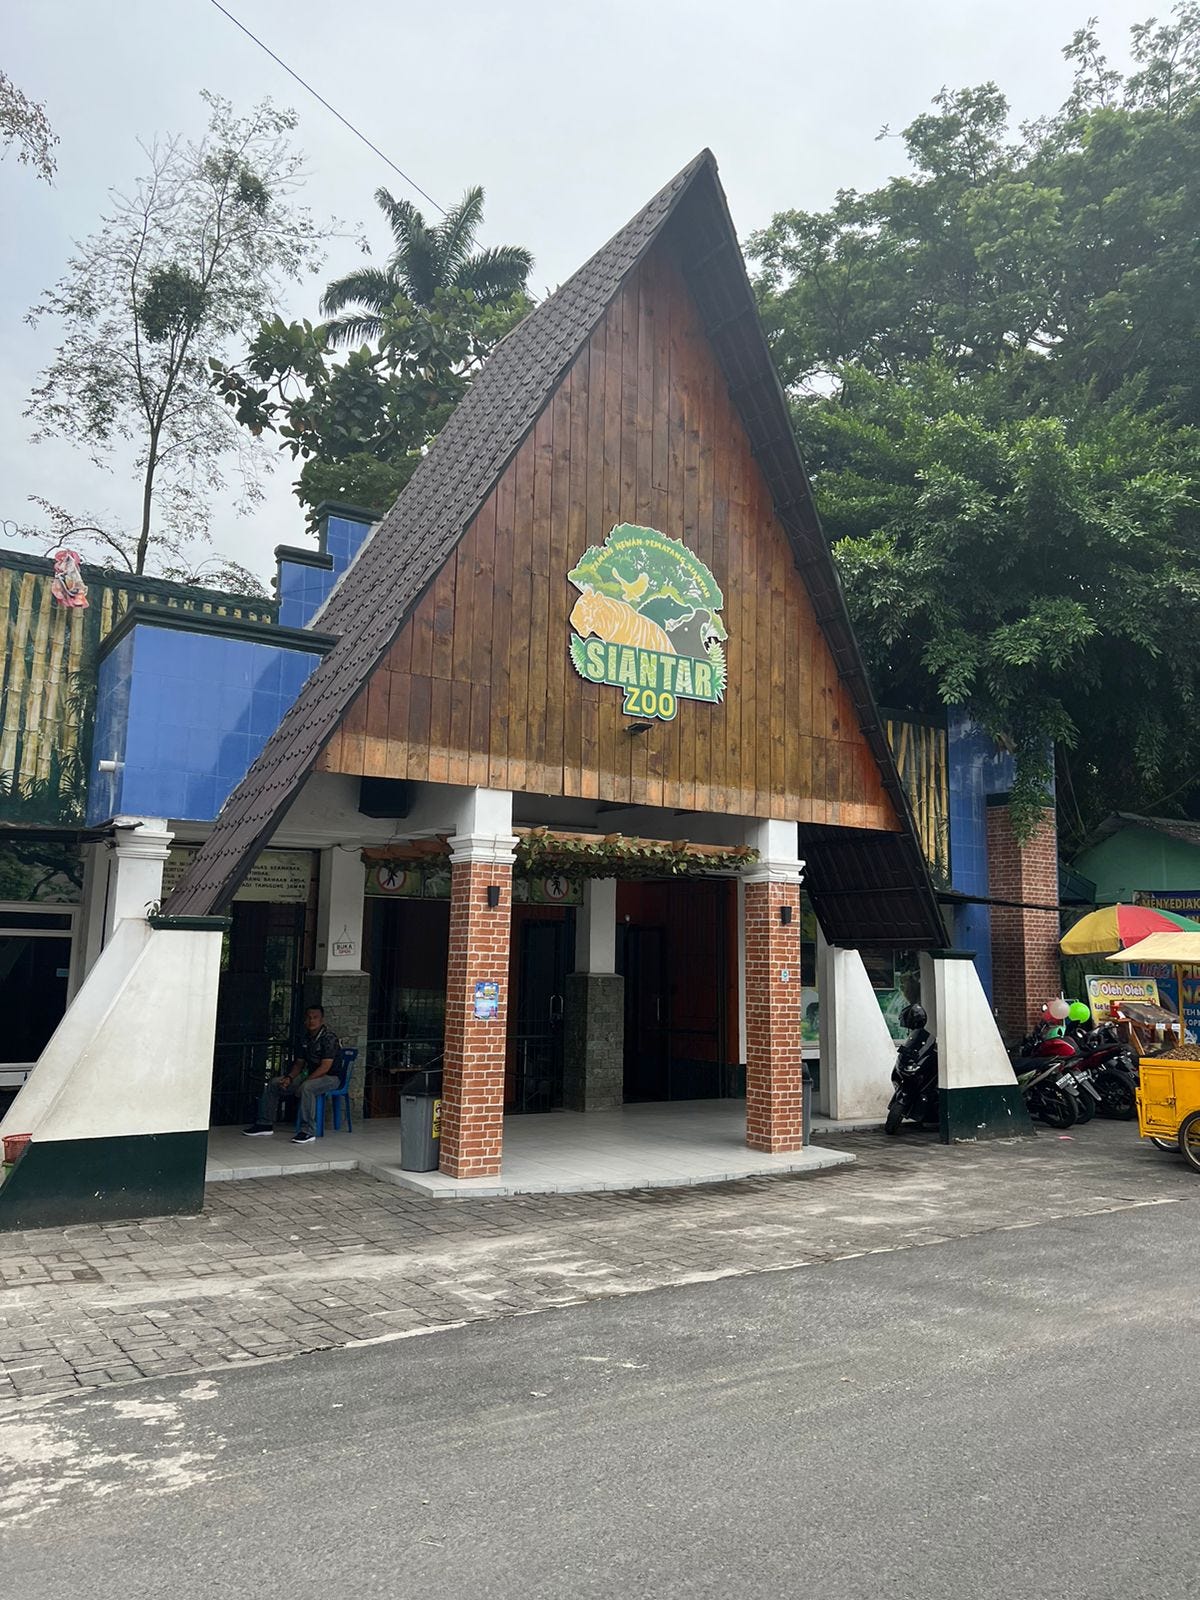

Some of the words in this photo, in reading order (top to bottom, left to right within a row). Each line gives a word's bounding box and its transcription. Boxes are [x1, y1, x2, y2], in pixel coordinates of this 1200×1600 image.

[590, 547, 614, 572] TAMAN
[615, 537, 643, 551] HEWAN
[645, 539, 687, 566] PEMATANG
[687, 563, 711, 598] SIANTAR
[586, 641, 711, 696] SIANTAR
[627, 688, 674, 716] ZOO
[1100, 983, 1123, 996] Oleh
[1123, 983, 1145, 997] Oleh
